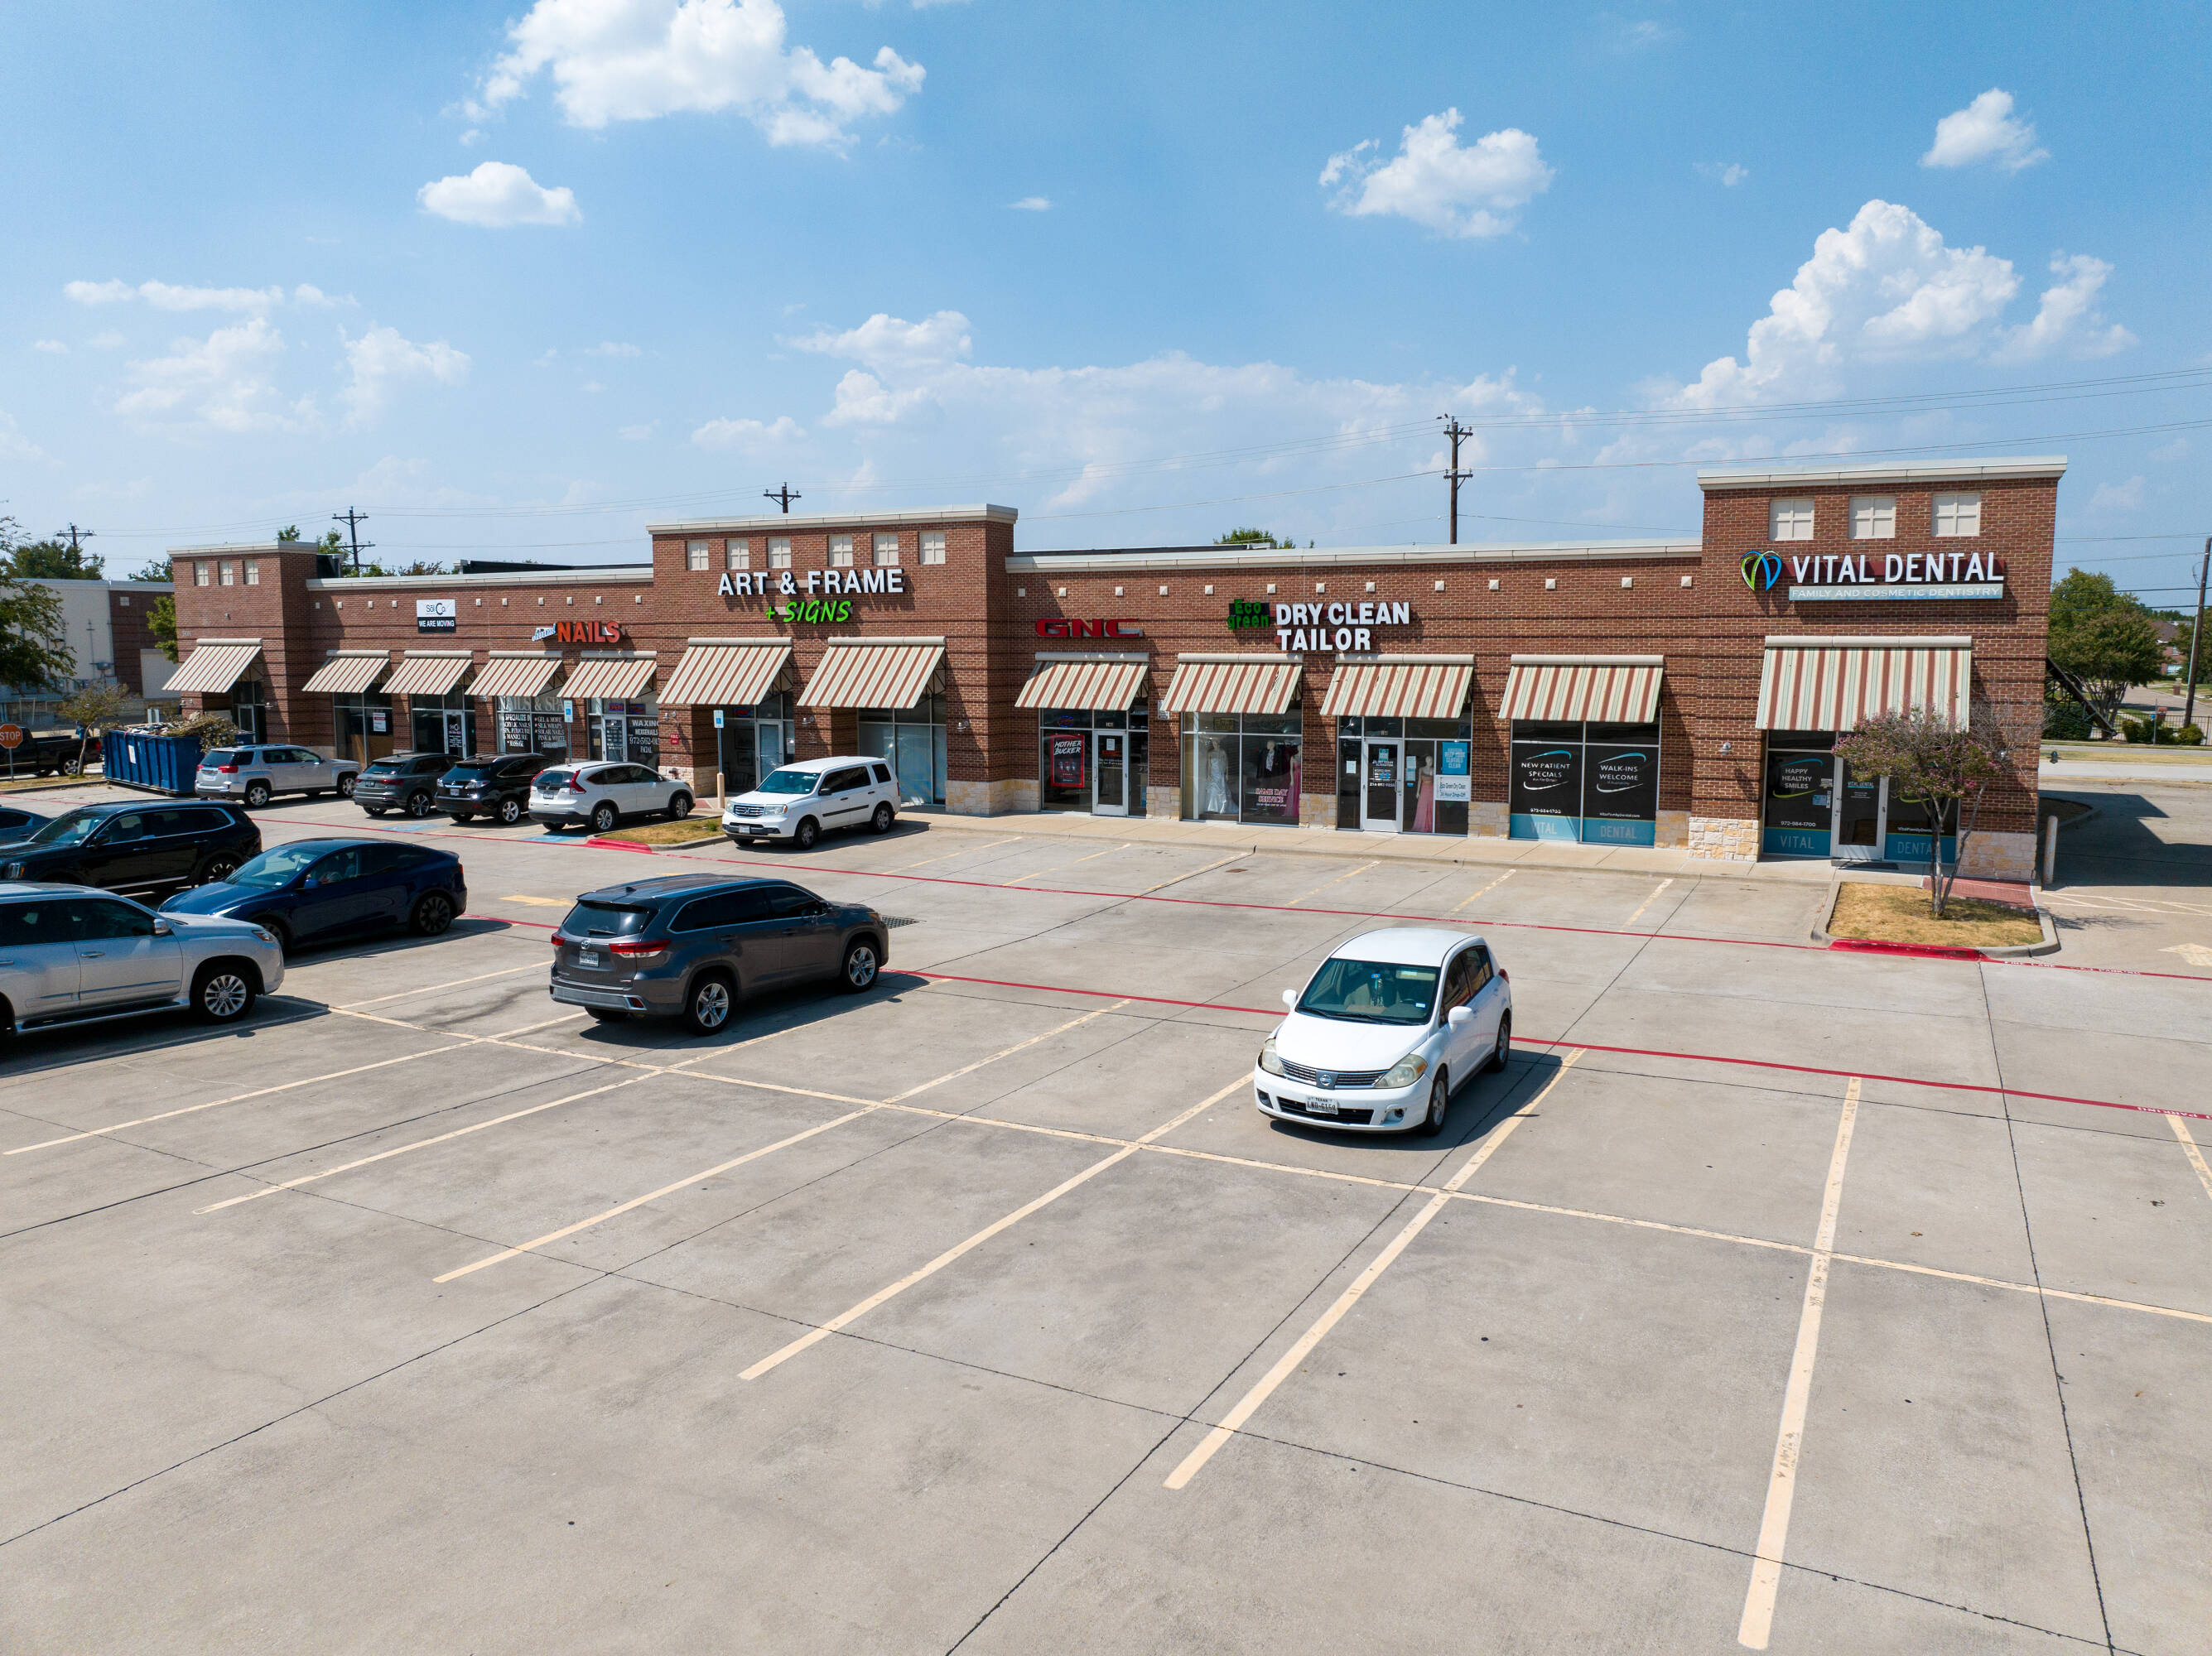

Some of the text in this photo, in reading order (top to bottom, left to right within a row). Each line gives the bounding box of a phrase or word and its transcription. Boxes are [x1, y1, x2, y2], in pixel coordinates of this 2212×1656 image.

[1792, 551, 2004, 584] VITAL DENTAL
[717, 568, 904, 596] ART & FRAME
[1791, 587, 2001, 598] FAMILY AND COSMETIC DENTISTRY
[783, 599, 852, 624] SIGNS
[1234, 599, 1261, 615] Eco
[1275, 602, 1410, 625] DRY CLEAN
[1035, 618, 1144, 638] GNC
[1226, 614, 1270, 631] green
[557, 621, 620, 643] NAILS
[1276, 628, 1371, 652] TAILOR
[499, 696, 531, 711] NAILS
[0, 730, 21, 742] STOP
[1053, 747, 1082, 756] BUCKER
[1054, 740, 1082, 749] MOTHER
[1600, 764, 1639, 773] WALK-INS
[1530, 821, 1558, 835] VITAL
[1600, 826, 1637, 840] DENTAL
[1780, 835, 1815, 850] VITAL
[1897, 841, 1932, 855] DENTA
